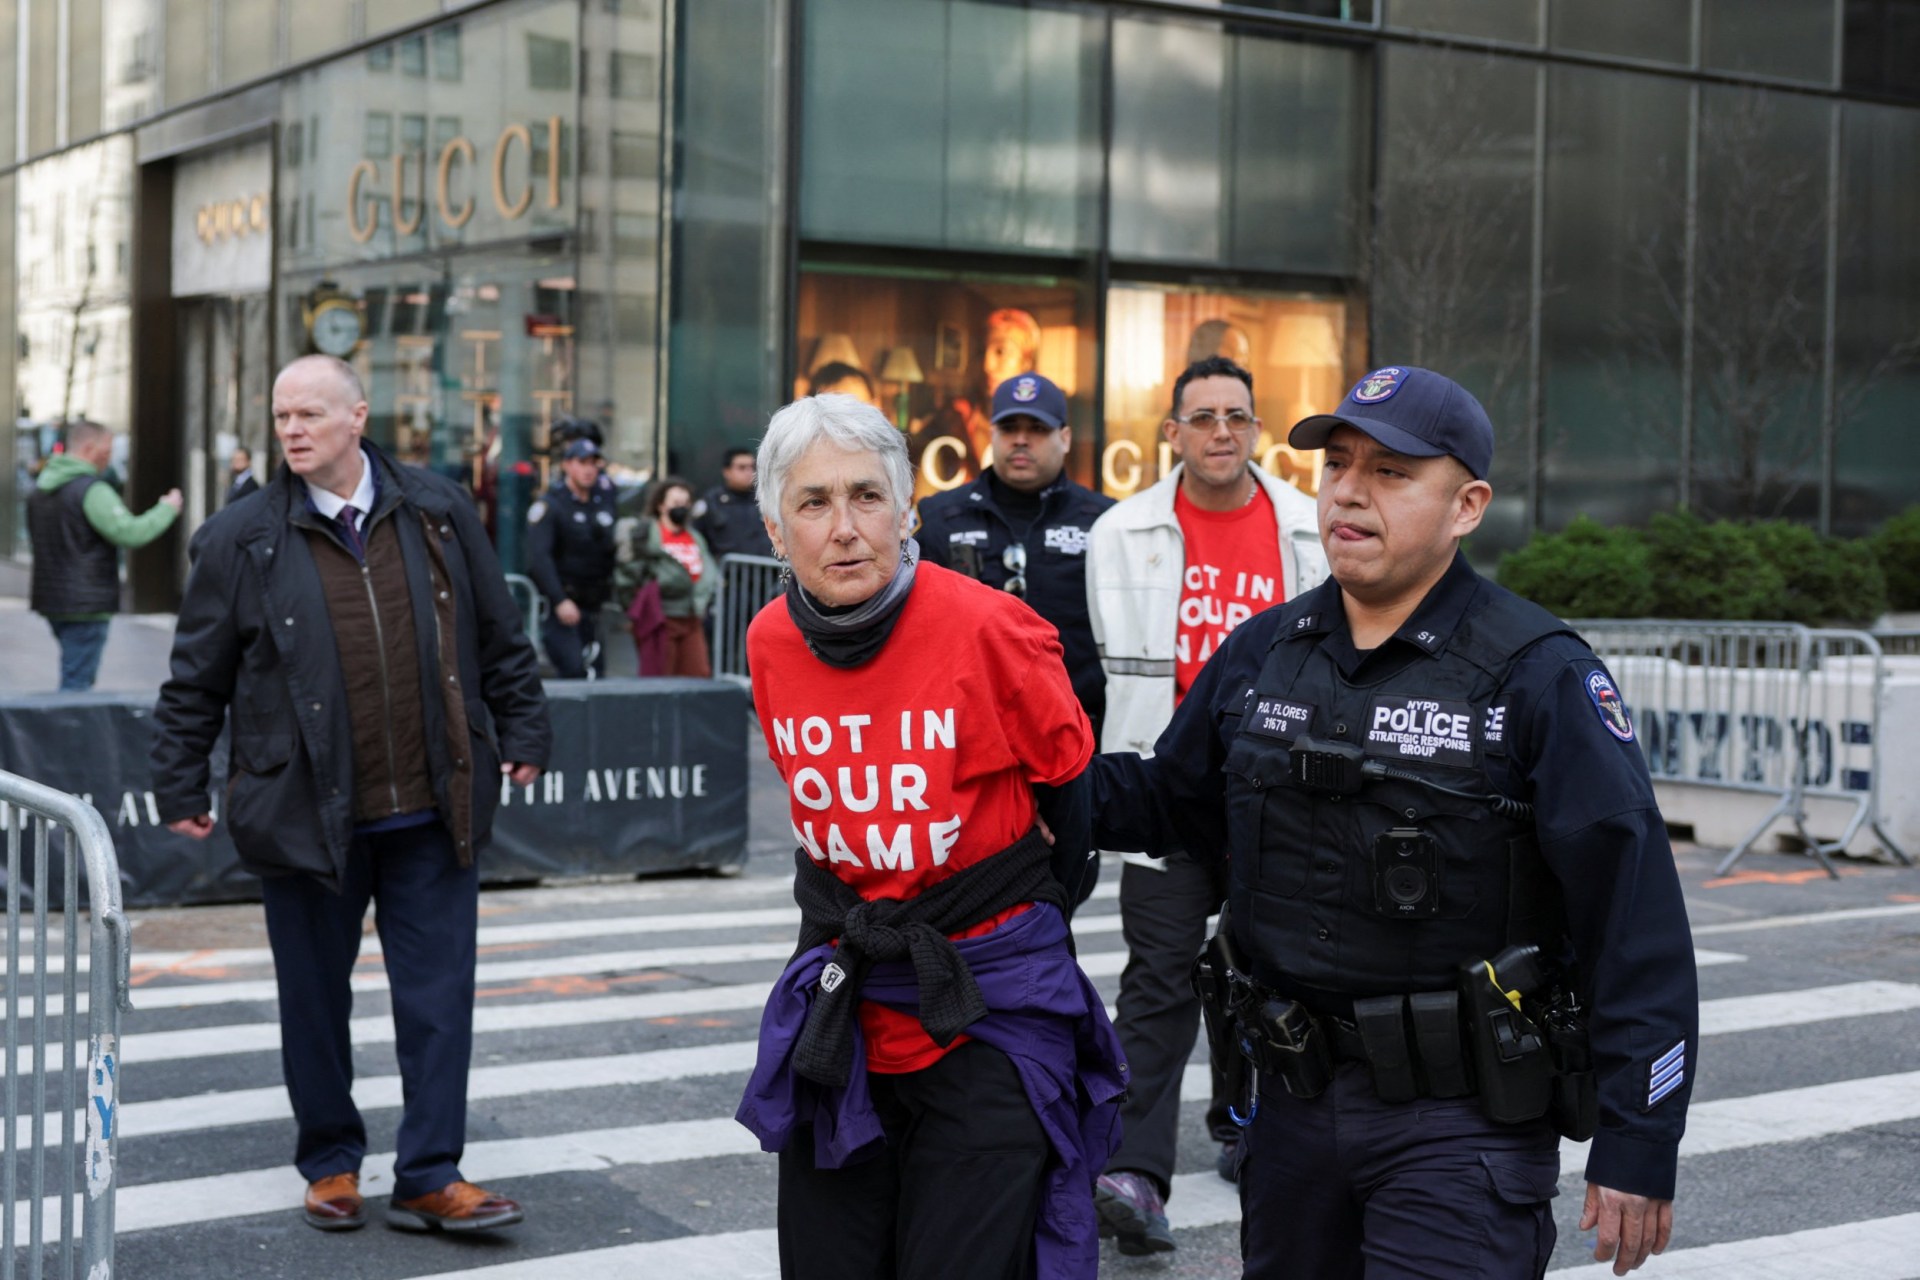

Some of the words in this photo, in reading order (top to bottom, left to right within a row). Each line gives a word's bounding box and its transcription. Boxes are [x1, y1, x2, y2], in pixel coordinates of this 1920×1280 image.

[347, 115, 561, 243] GUCCI
[1184, 564, 1220, 591] OT
[1235, 571, 1274, 602] IN
[1180, 595, 1252, 632] OUR
[1297, 616, 1312, 628] S1
[1417, 631, 1436, 644] S1
[1271, 703, 1308, 721] FLORES
[1406, 700, 1440, 713] NYPD
[772, 714, 871, 756] NOT
[901, 708, 956, 751] IN
[1262, 716, 1287, 732] 31678
[1373, 706, 1471, 740] POLICE
[1368, 730, 1419, 745] STRATEGIC
[1420, 735, 1471, 752] RESPONSE
[1399, 743, 1436, 757] GROUP
[583, 764, 708, 802] AVENUE
[793, 763, 931, 813] OUR
